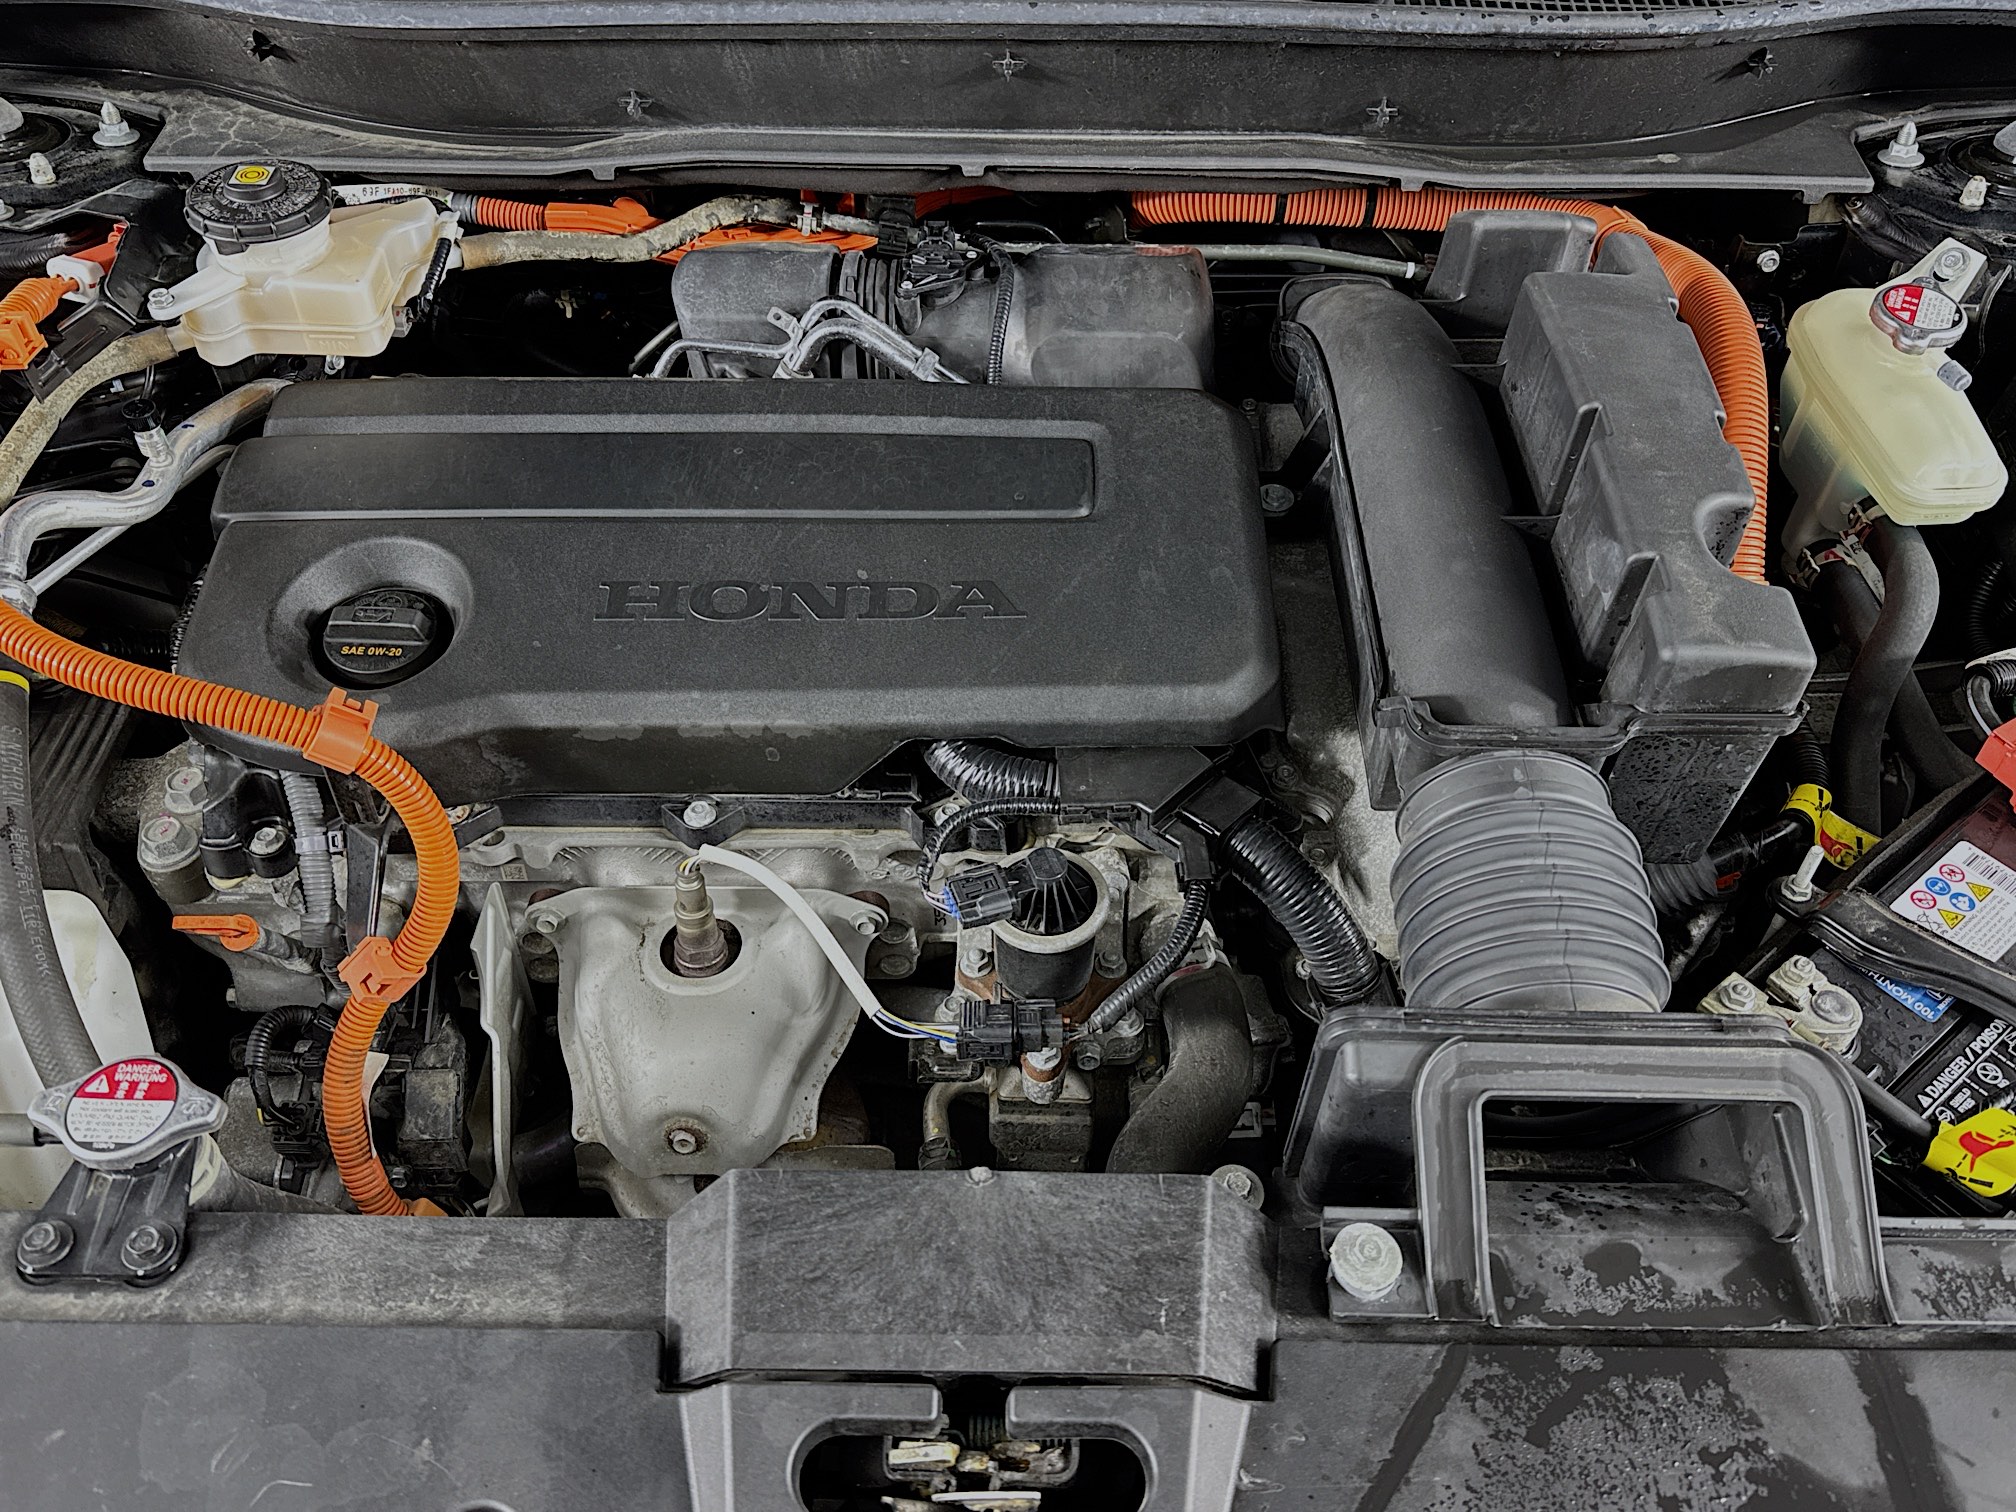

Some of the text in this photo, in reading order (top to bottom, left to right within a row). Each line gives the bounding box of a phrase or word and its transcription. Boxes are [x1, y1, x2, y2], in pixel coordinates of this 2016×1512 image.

[593, 581, 1027, 622] HONDA
[340, 645, 403, 657] SAE 0W-20
[1868, 971, 1935, 1019] 100 MONTH
[116, 1063, 162, 1074] DANGER
[1924, 1055, 1971, 1099] DANGER
[1969, 1018, 2009, 1054] POISON
[113, 1072, 168, 1083] WARNUNG
